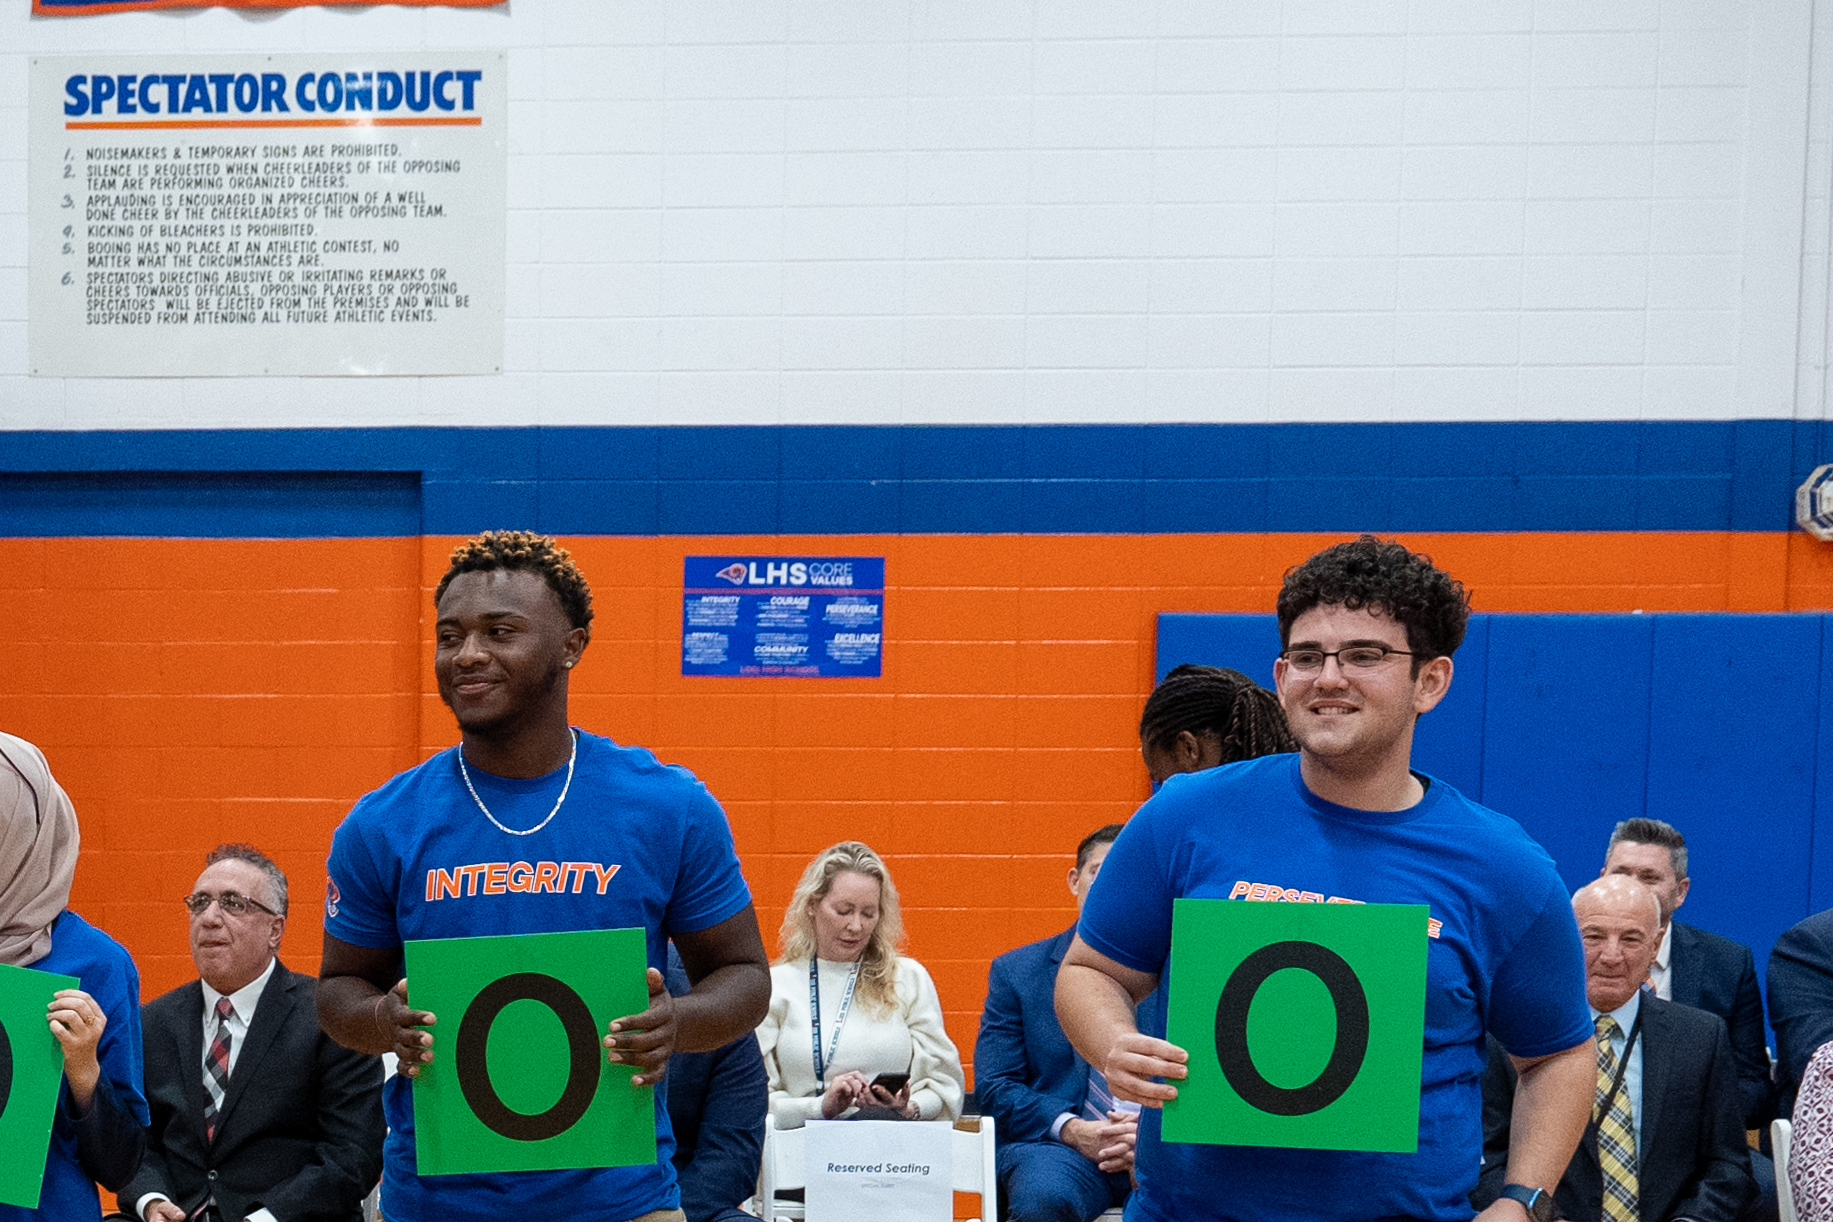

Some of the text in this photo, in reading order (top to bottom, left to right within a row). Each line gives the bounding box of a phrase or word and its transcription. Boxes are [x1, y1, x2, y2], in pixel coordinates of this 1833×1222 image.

[64, 70, 482, 116] SPECTATOR CONDUCT
[86, 147, 166, 159] NOISEMAKERS
[173, 147, 181, 159] &
[188, 146, 256, 158] TEMPORARY
[262, 145, 296, 157] SIGNS
[302, 145, 324, 157] ARE
[331, 144, 401, 156] PROHIBITED.
[63, 161, 460, 179] 2. SILENCE IS REQUESTED WHEN CHEERLEADERS OF THE OPPOSING
[87, 176, 348, 190] TEAM ARE PERFORMING ORGANIZED CHEERS.
[86, 195, 156, 207] APPLAUDING
[162, 194, 172, 206] IS
[179, 194, 255, 206] ENCOURAGED
[261, 193, 272, 205] IN
[278, 192, 358, 204] APPRECIATION
[364, 192, 378, 204] OF
[384, 192, 392, 204] A
[397, 191, 425, 203] WELL
[86, 205, 446, 220] DONE CHEER BY THE CHEERLEADERS OF THE OPPOSING TEAM.
[88, 226, 134, 237] KICKING
[140, 225, 153, 237] OF
[160, 225, 224, 236] BLEACHERS
[230, 224, 241, 236] IS
[247, 224, 316, 235] PROHIBITED.
[88, 243, 131, 254] BOOING
[137, 242, 159, 254] HAS
[165, 242, 181, 254] NO
[186, 242, 220, 253] PLACE
[226, 241, 239, 253] AT
[245, 241, 260, 253] AN
[266, 240, 316, 252] ATHLETIC
[322, 240, 376, 252] CONTEST,
[383, 239, 399, 251] NO
[87, 254, 323, 268] MATTER WHAT THE CIRCUMSTANCES ARE.
[61, 268, 446, 286] 6. SPECTATORS DIRECTING ABUSIVE OR IRRITATING REMARKS OR
[86, 286, 130, 298] CHEERS
[136, 285, 189, 297] TOWARDS
[260, 284, 317, 296] OPPOSING
[323, 283, 372, 295] PLAYERS
[378, 282, 394, 294] OR
[400, 282, 457, 294] OPPOSING
[86, 295, 468, 311] SPECTATORS WILL BE EJECTED FROM THE PREMISES AND WILL BE
[86, 309, 436, 325] SUSPENDED FROM ATTENDING ALL FUTURE ATHLETIC EVENTS.
[748, 562, 853, 585] LHS CORE
[810, 576, 853, 586] VALUES
[425, 861, 621, 902] INTEGRITY
[827, 1162, 930, 1175] Reserved Seating
